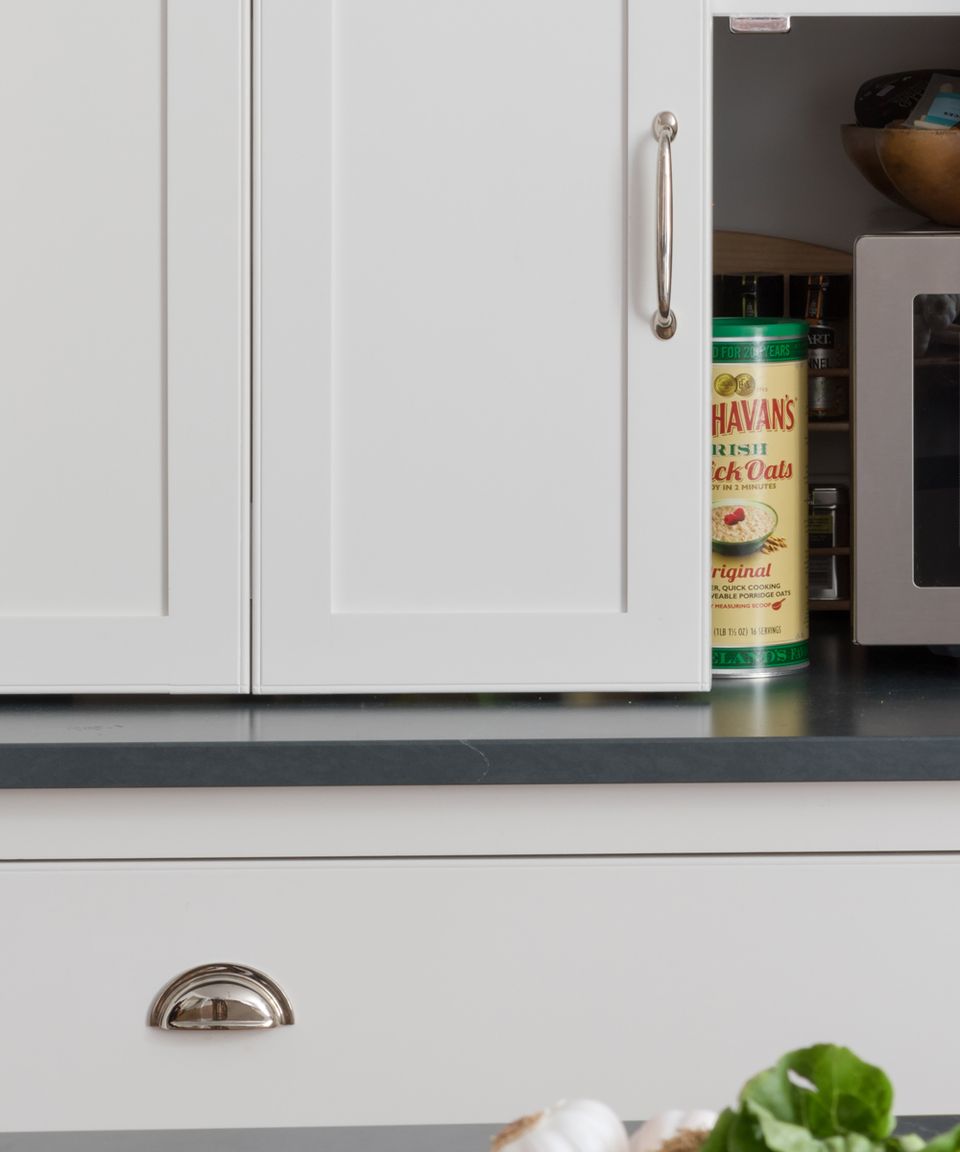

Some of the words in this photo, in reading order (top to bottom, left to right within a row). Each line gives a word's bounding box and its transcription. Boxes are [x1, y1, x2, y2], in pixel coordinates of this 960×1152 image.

[745, 459, 793, 482] Oats
[741, 483, 777, 491] MINUTES
[712, 563, 772, 583] riginal
[748, 583, 781, 591] COOKING
[739, 592, 774, 600] PORRIDGE
[775, 590, 791, 598] OATS
